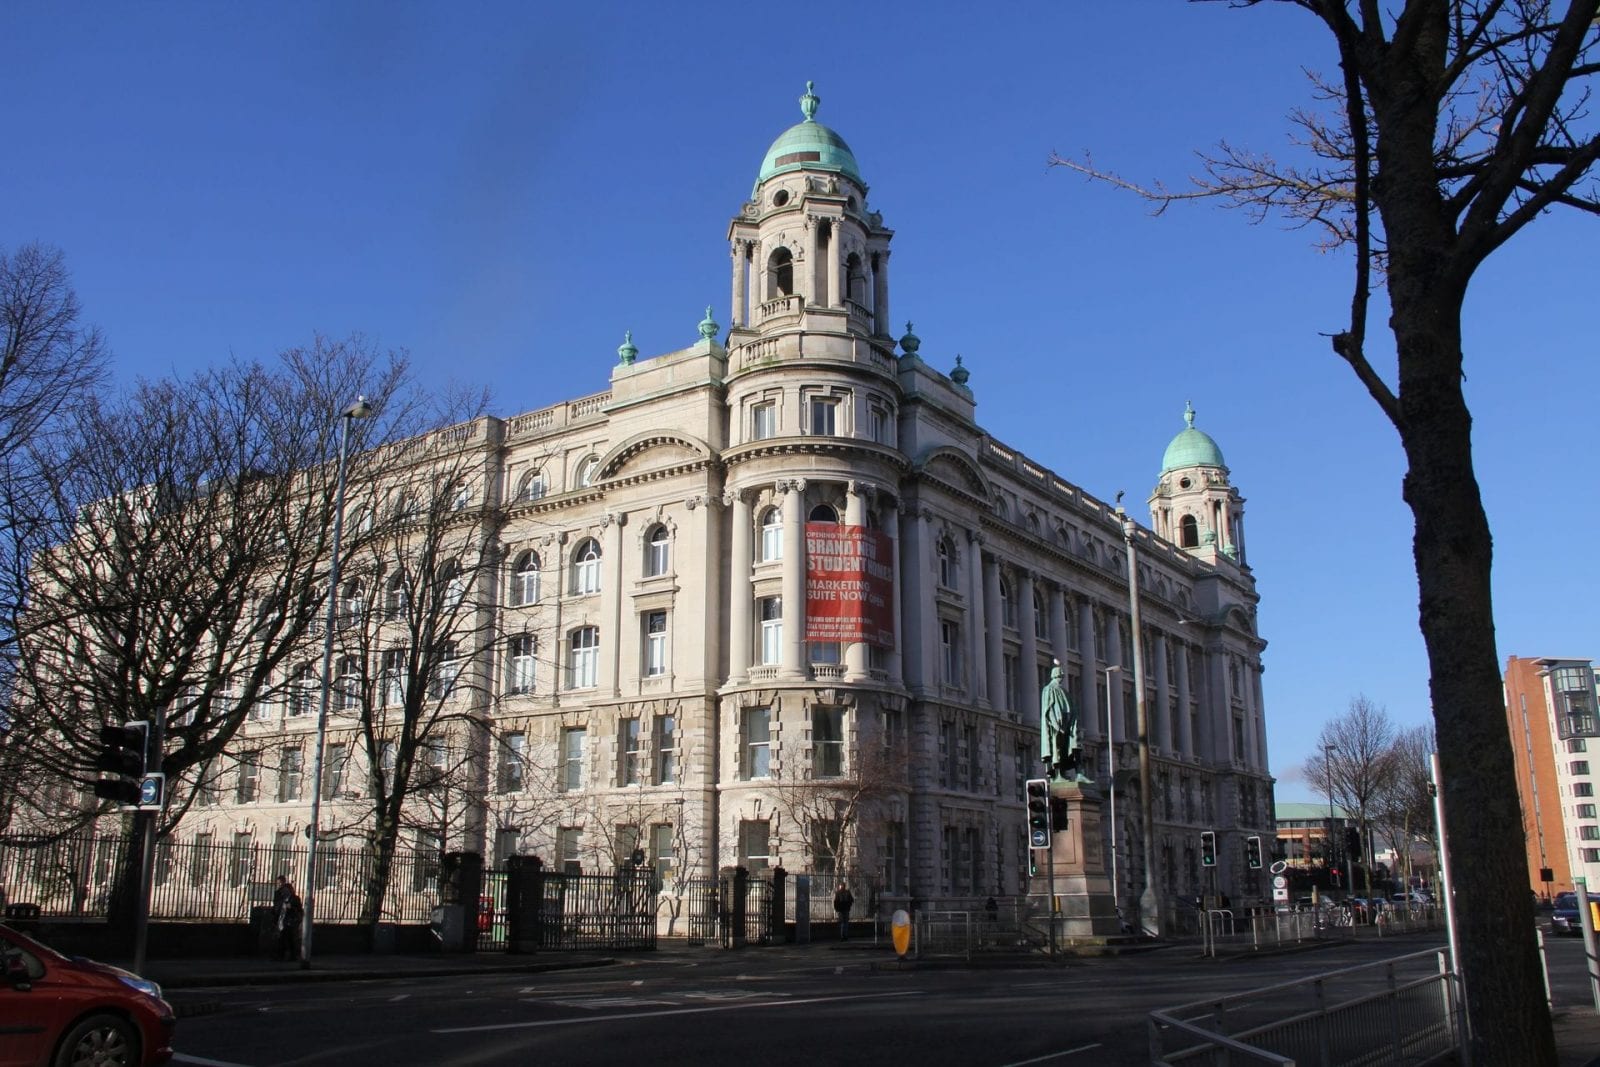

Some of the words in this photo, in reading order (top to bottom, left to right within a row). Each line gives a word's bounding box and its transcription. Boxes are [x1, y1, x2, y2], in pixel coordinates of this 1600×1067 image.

[807, 539, 853, 556] BRAND
[856, 541, 877, 560] NEW
[807, 555, 867, 572] STUDENT
[807, 580, 870, 592] MARKETING
[807, 590, 836, 600] SUITE
[840, 591, 867, 601] NOW
